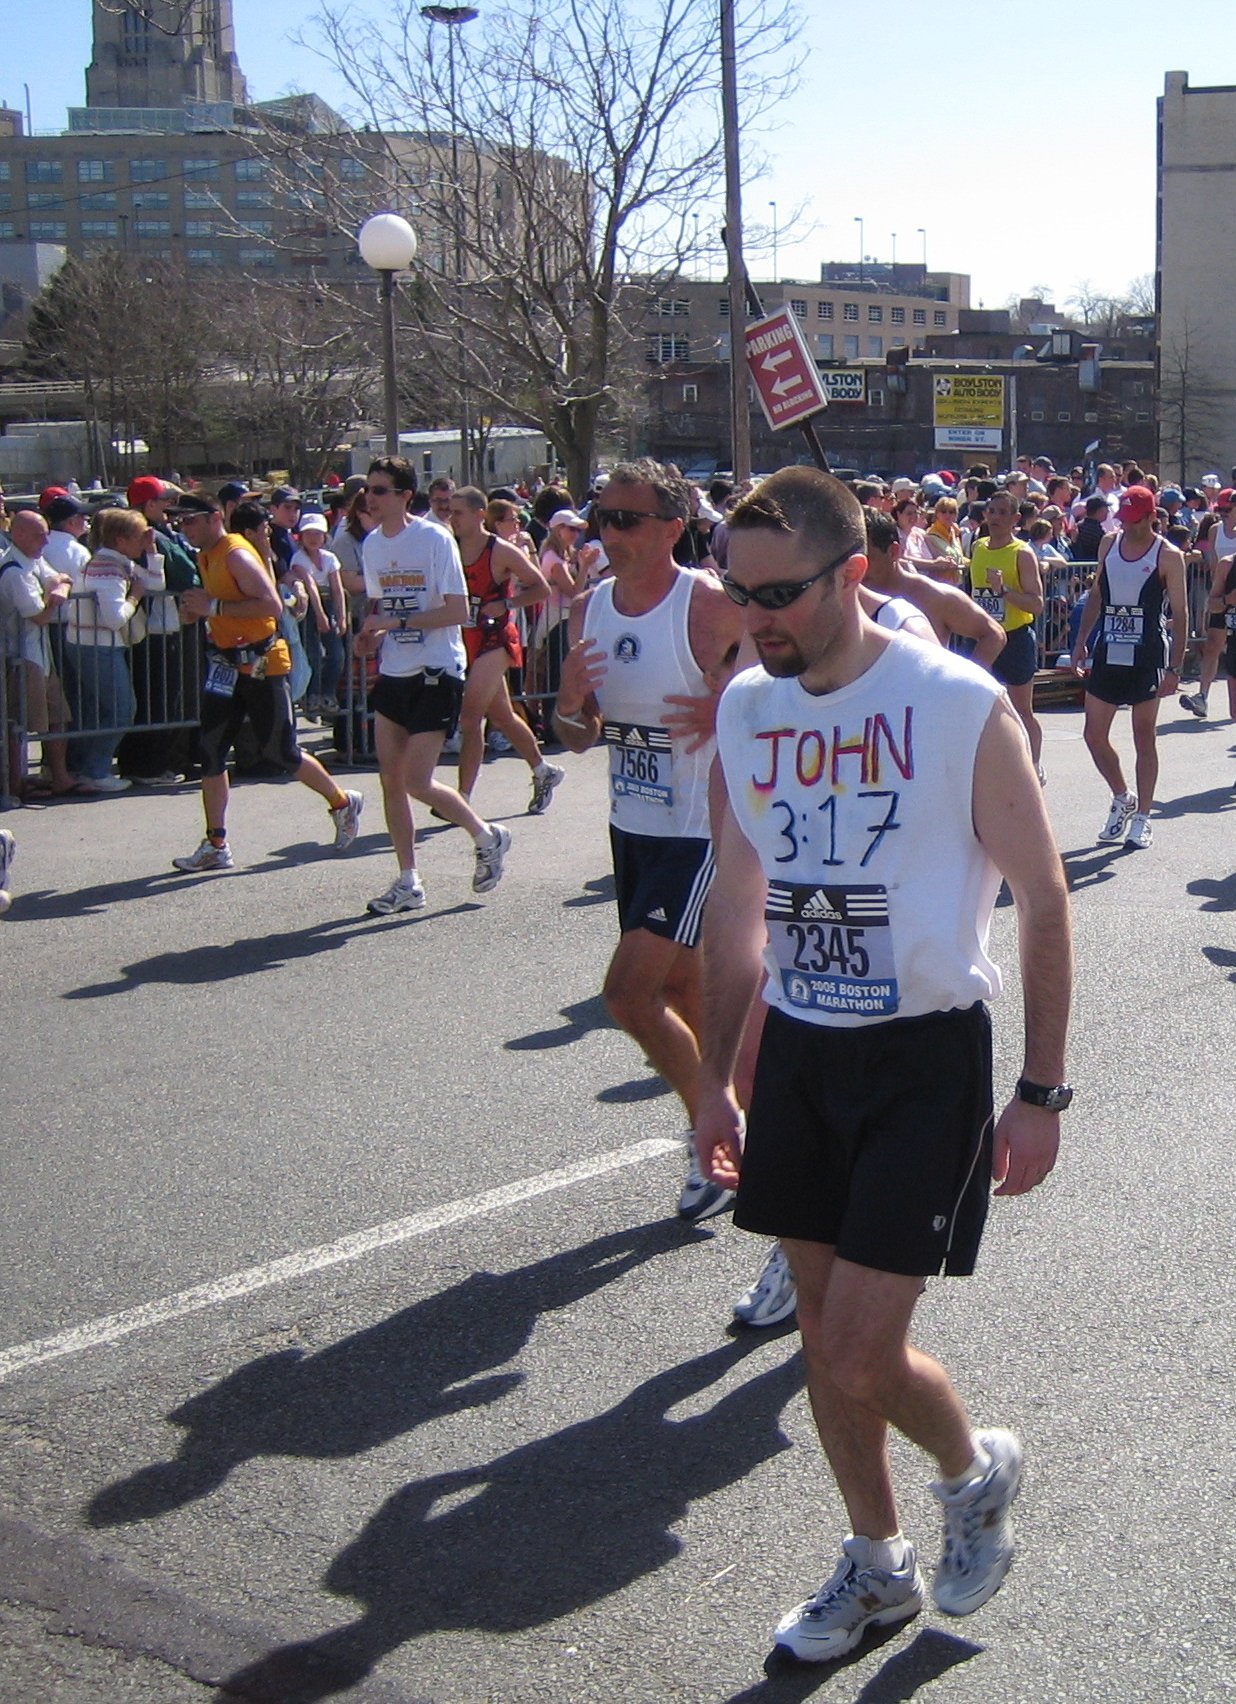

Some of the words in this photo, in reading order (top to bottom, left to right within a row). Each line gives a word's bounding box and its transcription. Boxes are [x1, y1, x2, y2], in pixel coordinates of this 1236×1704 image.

[745, 323, 794, 359] PARKING
[954, 377, 1002, 388] BOYLSTON
[832, 387, 863, 399] BODY
[954, 388, 976, 397] AUTO
[977, 388, 1001, 397] BODY
[1110, 617, 1135, 632] 1284
[752, 706, 915, 793] JOHN
[616, 747, 659, 784] 7566
[772, 790, 902, 868] 3:17
[801, 909, 843, 921] adidas
[786, 923, 870, 978] 2345
[810, 980, 836, 994] 2005
[839, 984, 891, 998] BOSTON
[816, 993, 885, 1011] MARATHON
